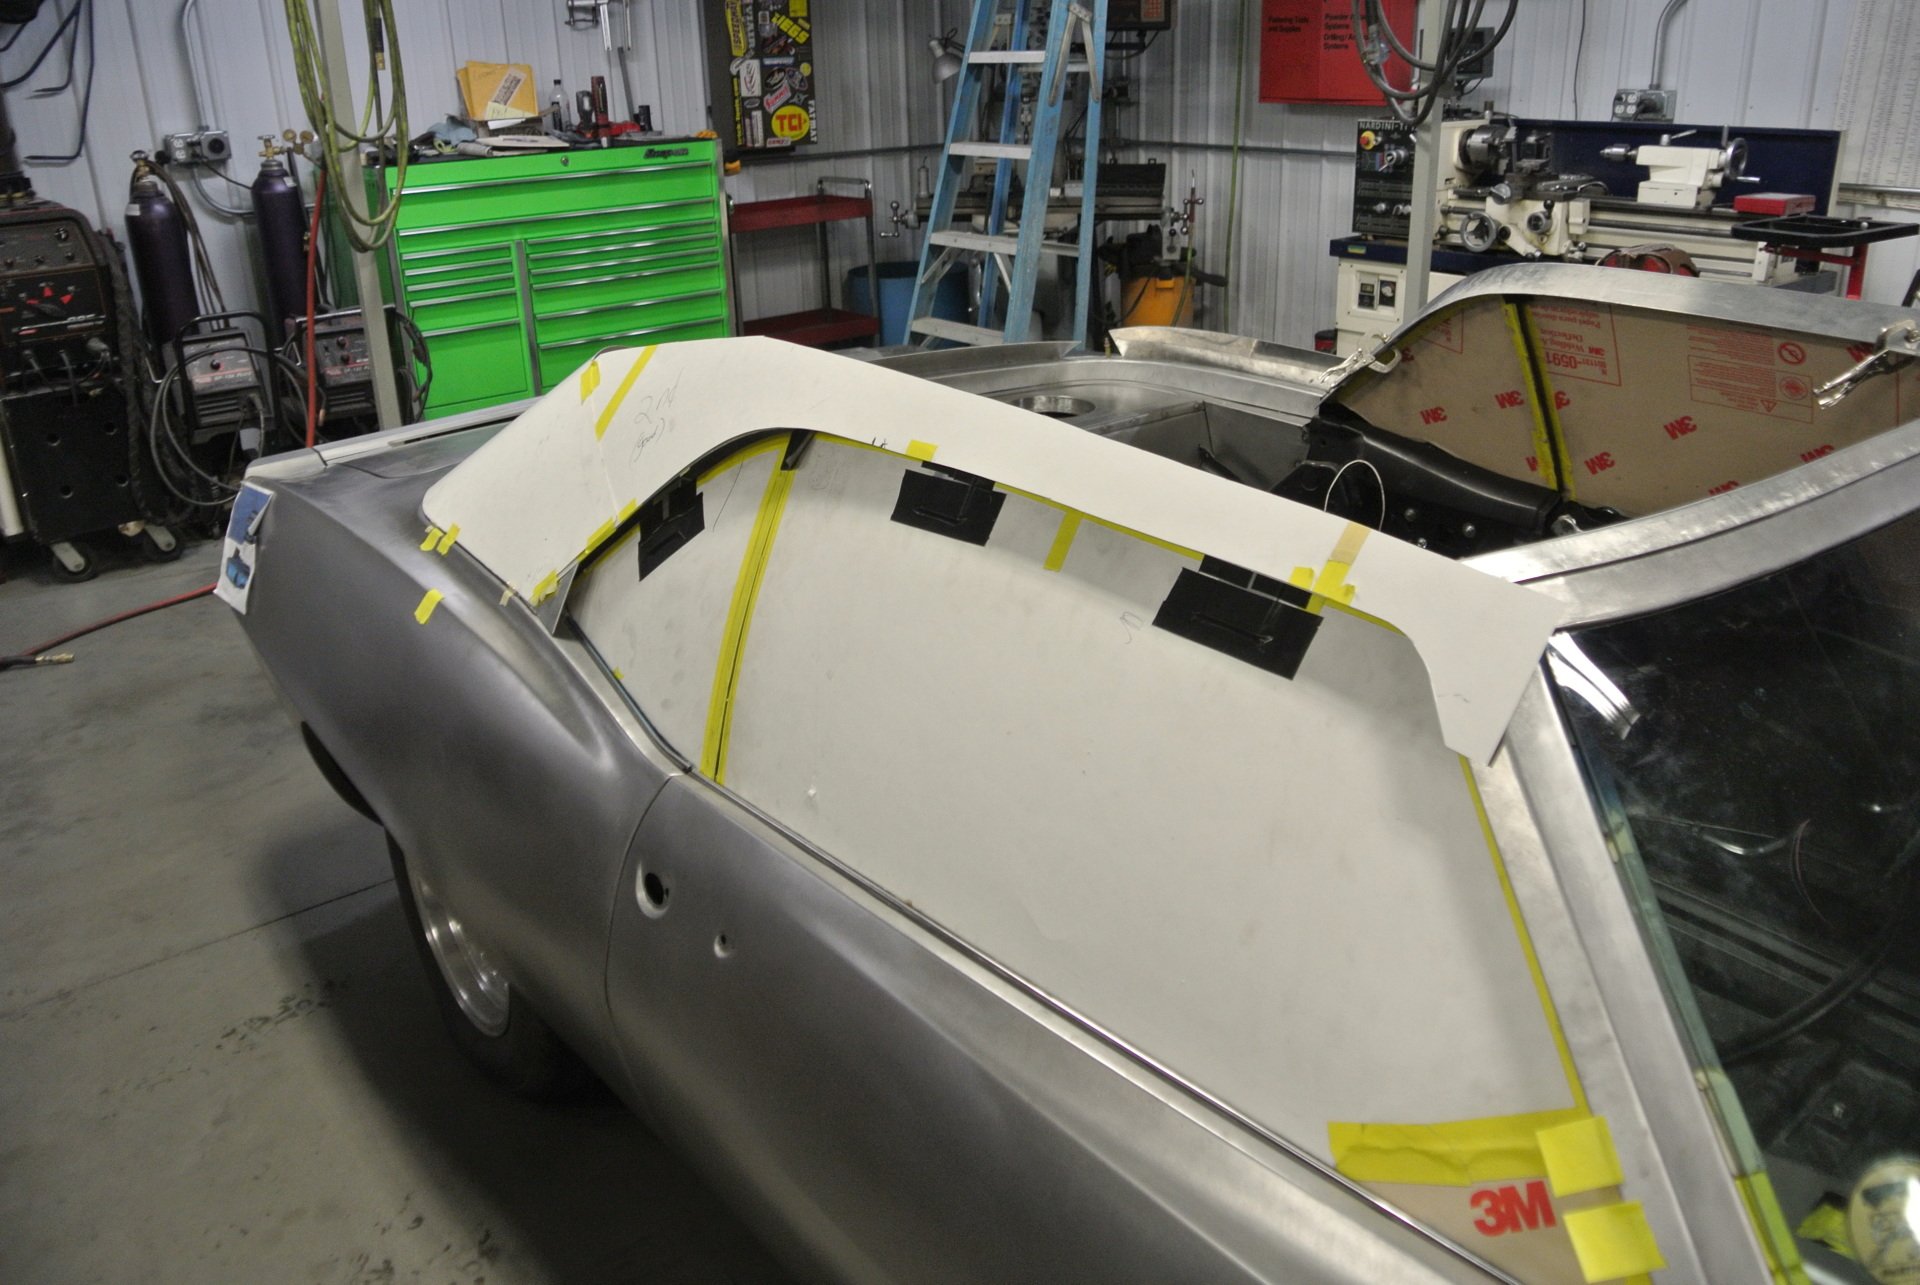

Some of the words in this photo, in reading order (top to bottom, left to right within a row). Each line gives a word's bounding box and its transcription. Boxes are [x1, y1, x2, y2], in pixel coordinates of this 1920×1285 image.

[771, 12, 810, 44] JEGS
[775, 113, 803, 132] TCI
[1495, 390, 1526, 410] 3M
[1420, 406, 1448, 425] 3M
[1663, 415, 1698, 441] 3M
[1584, 451, 1616, 476] 3M
[1469, 1180, 1557, 1238] 3M
